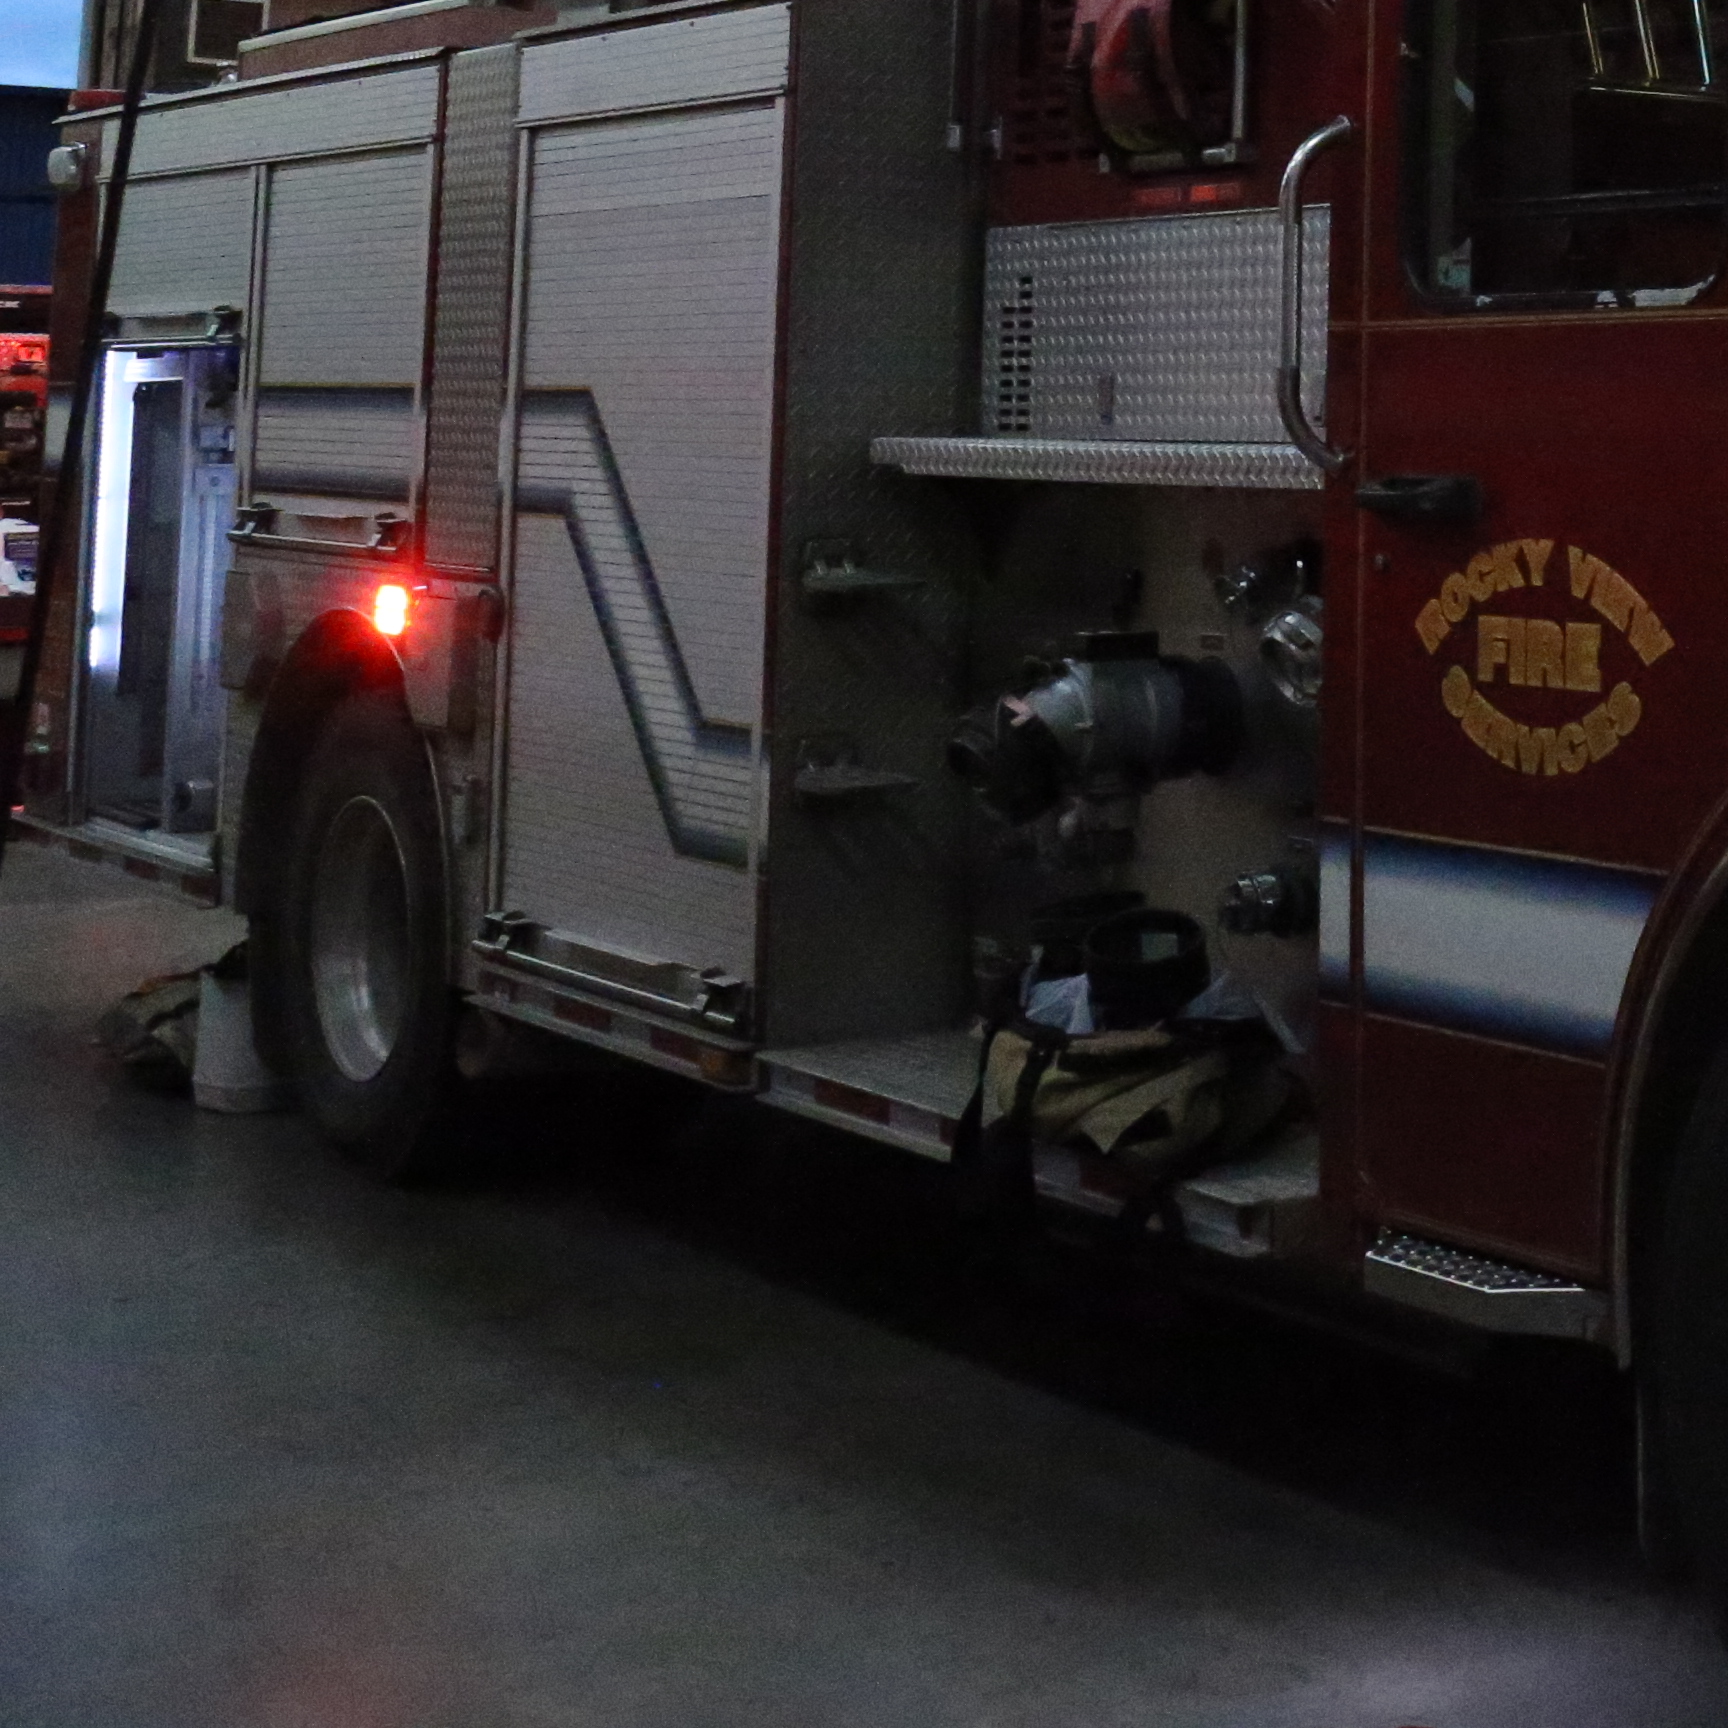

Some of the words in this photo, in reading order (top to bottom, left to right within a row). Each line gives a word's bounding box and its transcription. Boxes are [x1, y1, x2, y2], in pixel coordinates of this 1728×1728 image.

[1415, 538, 1555, 655] ROCKY
[1567, 544, 1676, 667] VIEW
[1477, 613, 1602, 692] FIRE
[1441, 665, 1642, 776] SERVICES
